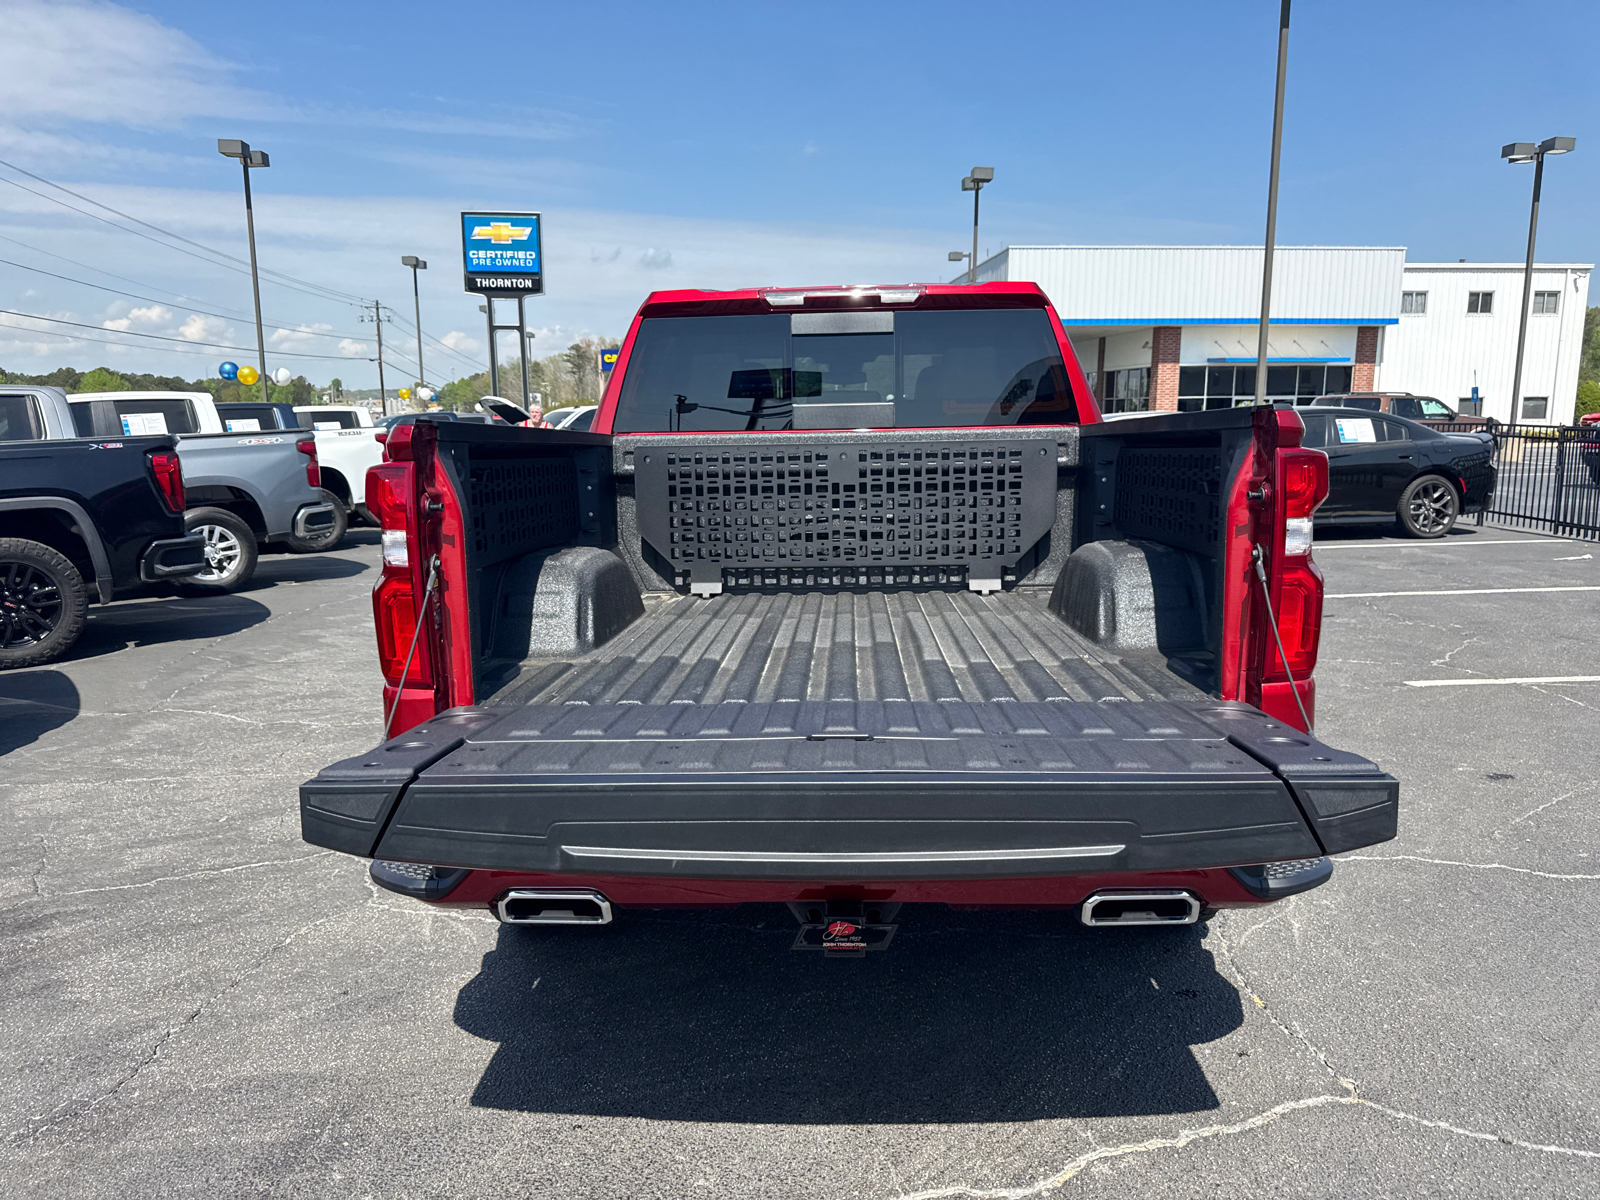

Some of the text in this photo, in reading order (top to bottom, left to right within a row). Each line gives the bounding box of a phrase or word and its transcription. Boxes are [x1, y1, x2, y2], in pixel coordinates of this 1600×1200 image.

[469, 250, 536, 259] CERTIFIED
[473, 258, 533, 266] PRE-OWNED
[475, 278, 533, 288] THORNTON
